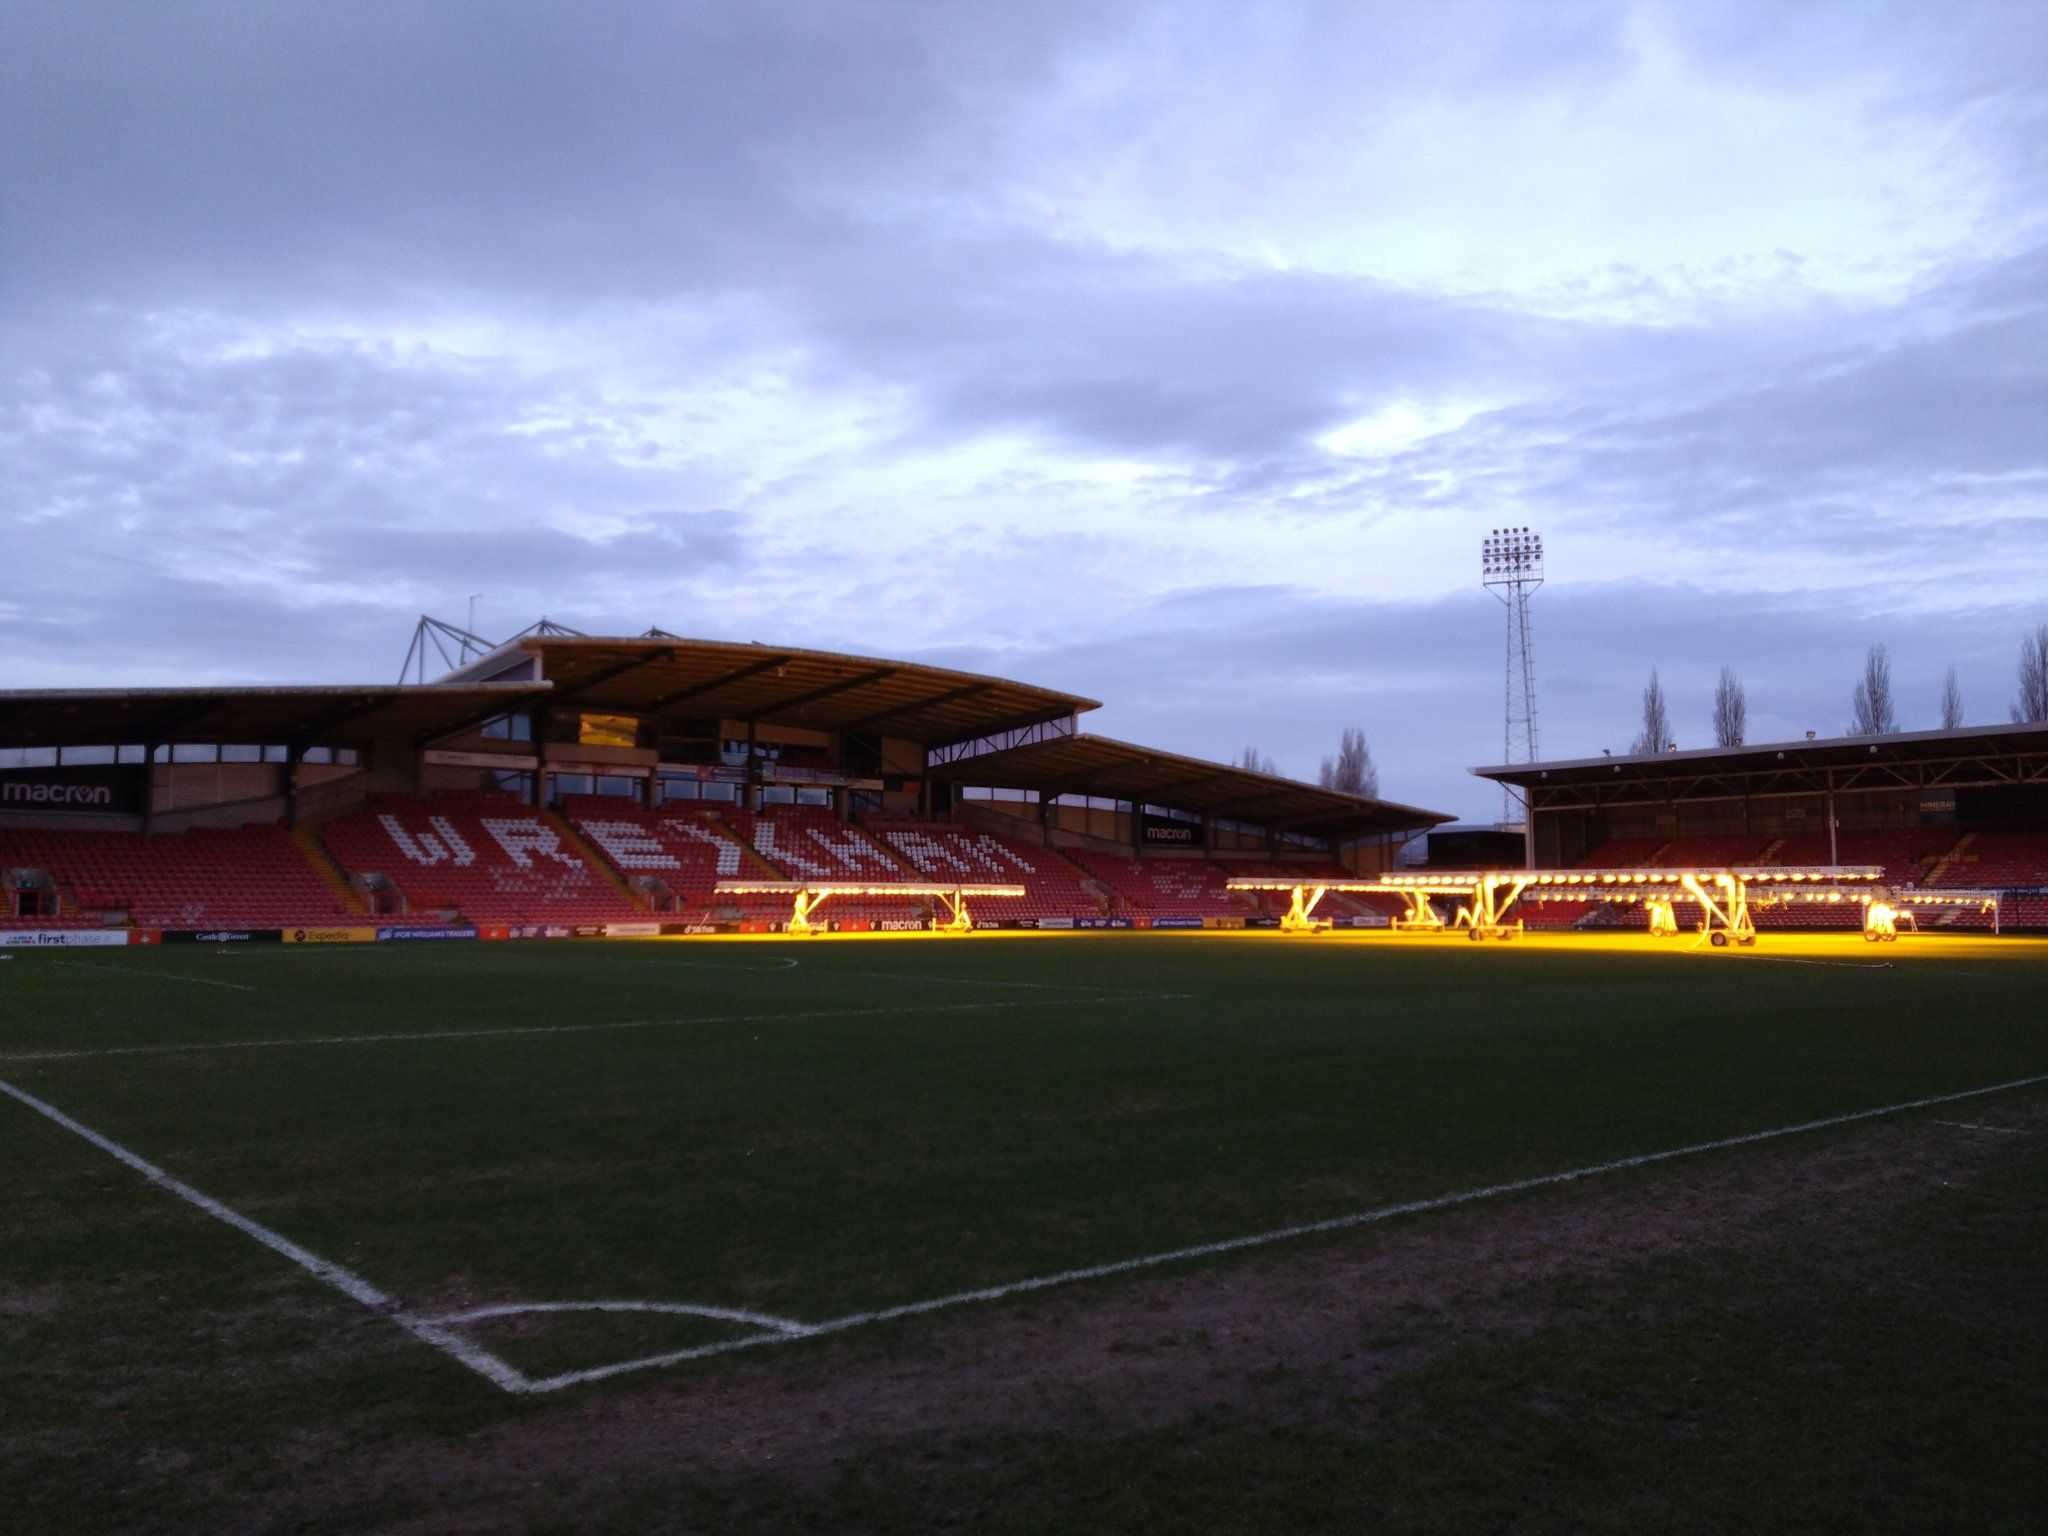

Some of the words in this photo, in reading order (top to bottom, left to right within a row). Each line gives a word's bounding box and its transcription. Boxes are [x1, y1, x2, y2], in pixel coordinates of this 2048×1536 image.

[2, 782, 111, 804] macron
[1147, 827, 1192, 840] macron
[882, 920, 922, 931] macron
[196, 933, 219, 941] Castle
[226, 933, 249, 941] Green
[308, 931, 349, 941] Expedia
[412, 930, 445, 938] WILLIAMS
[446, 929, 476, 937] TRAILERS
